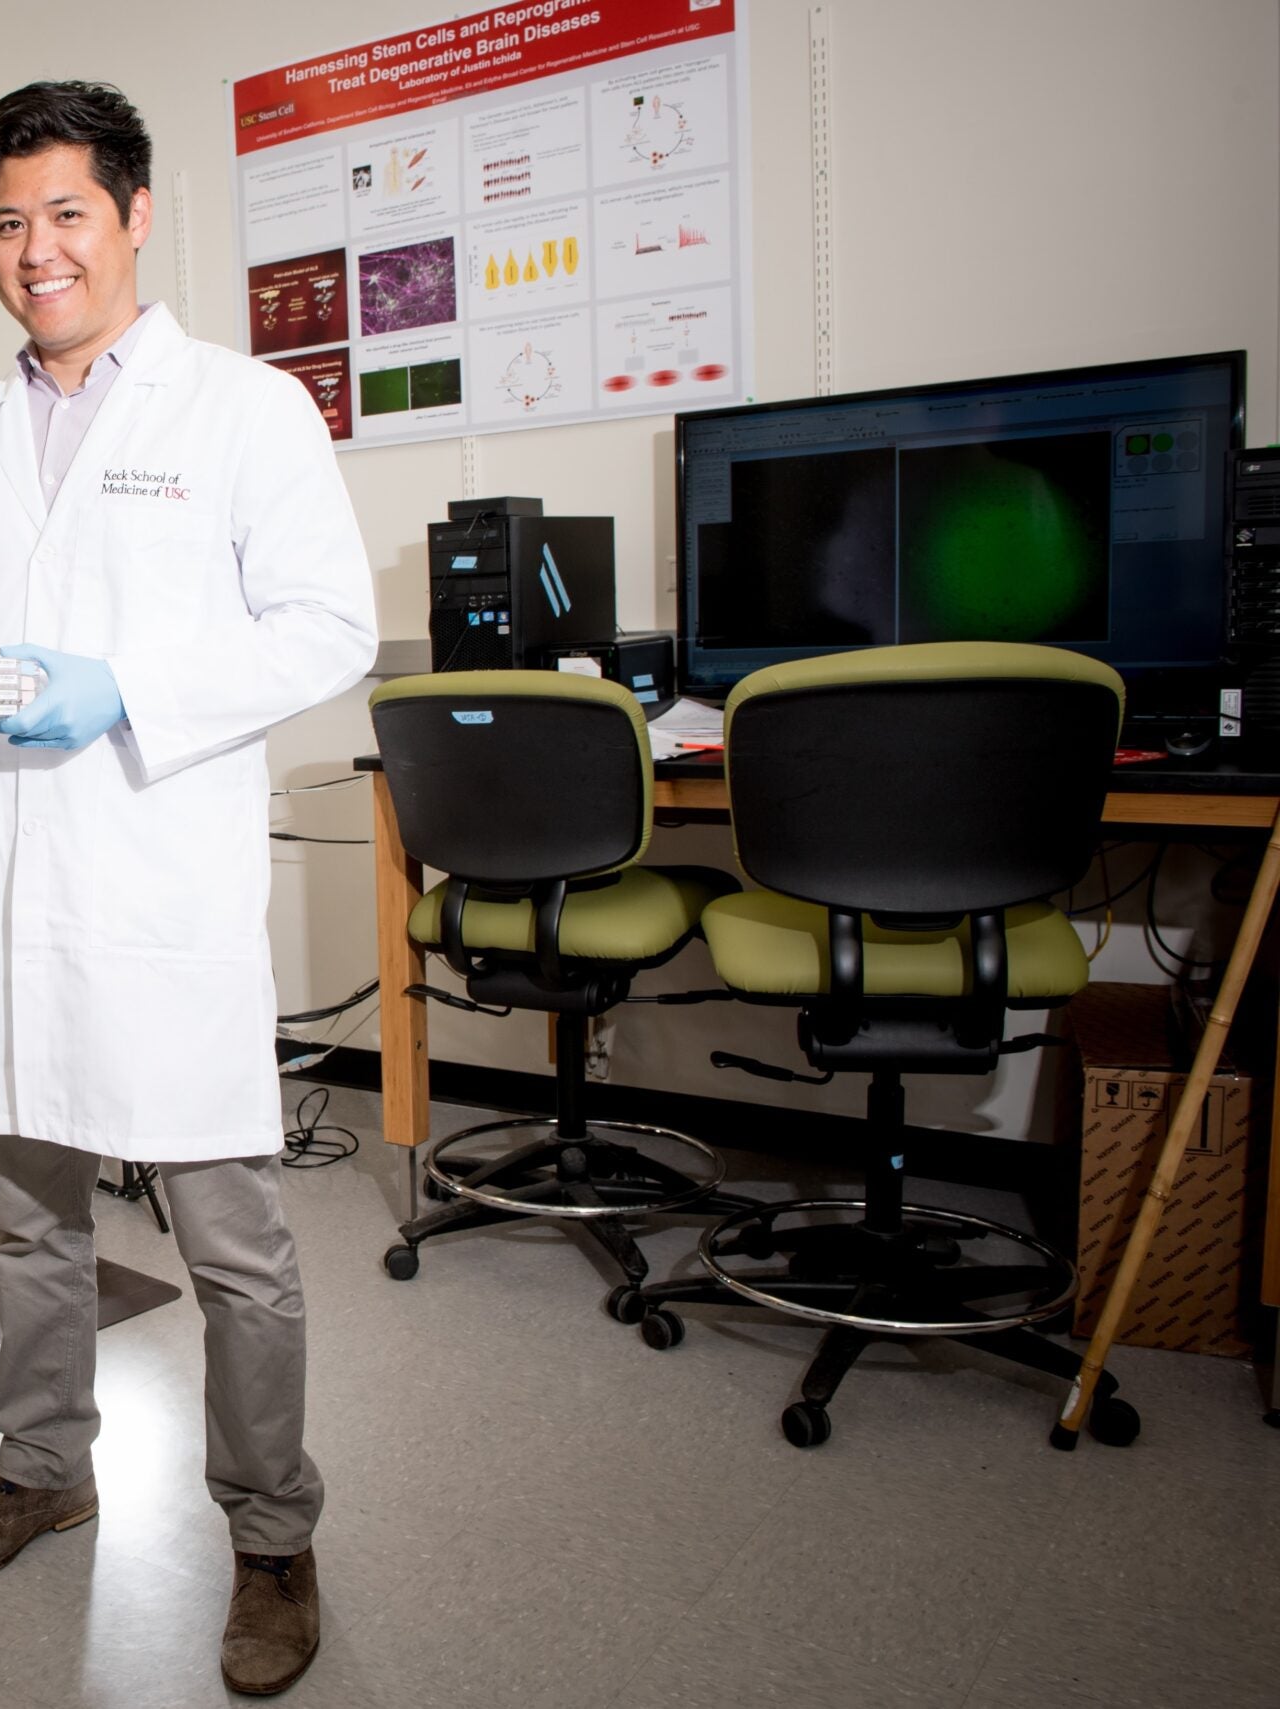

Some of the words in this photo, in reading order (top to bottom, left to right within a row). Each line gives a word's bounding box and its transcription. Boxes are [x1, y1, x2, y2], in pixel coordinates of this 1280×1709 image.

[285, 54, 368, 84] Harnessing
[372, 41, 411, 61] Stem
[416, 28, 455, 49] Cells
[460, 18, 489, 38] and
[328, 73, 365, 93] Treat
[369, 47, 472, 83] Degenerative
[477, 32, 519, 56] Brain
[524, 10, 600, 42] Diseases
[399, 70, 448, 90] Laboratory
[451, 66, 460, 76] of
[462, 58, 491, 74] Justin
[493, 50, 522, 66] Ichida
[240, 114, 257, 128] USC
[258, 110, 277, 122] Stem
[278, 104, 294, 116] Cell
[100, 484, 148, 496] Medicine
[150, 486, 162, 498] of
[164, 486, 191, 500] USC
[104, 470, 128, 481] Keck
[130, 470, 166, 484] School
[168, 474, 181, 485] of
